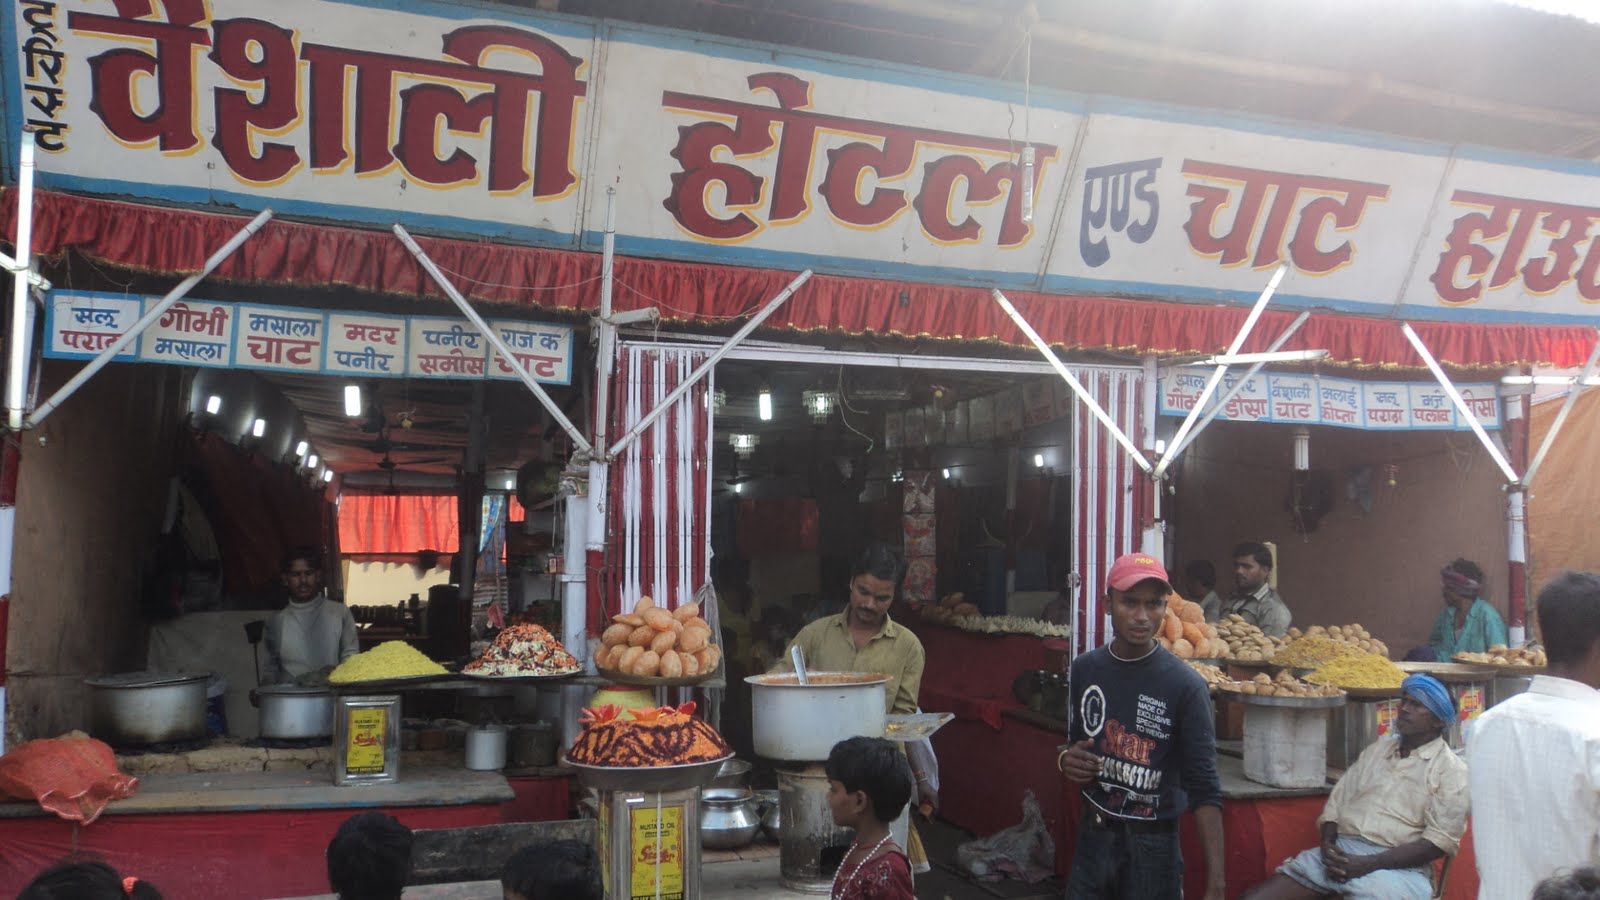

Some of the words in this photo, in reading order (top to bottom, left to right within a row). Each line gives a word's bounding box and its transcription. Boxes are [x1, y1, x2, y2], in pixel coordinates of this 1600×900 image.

[662, 72, 1058, 249] होटल
[1181, 158, 1391, 275] चाट
[249, 314, 321, 337] मसाला
[344, 324, 400, 345] मटर
[422, 325, 482, 349] पनीर
[155, 338, 227, 361] मसाला
[247, 336, 320, 365] चाट
[334, 346, 394, 372] पनीर
[1275, 402, 1312, 418] चाट
[1137, 702, 1156, 713] MADE
[1156, 708, 1166, 716] OF
[1138, 693, 1168, 709] ORIGINAL
[1136, 717, 1162, 731] SPECIAL
[1137, 709, 1172, 727] EXCLUSIVE
[1136, 724, 1146, 734] TO
